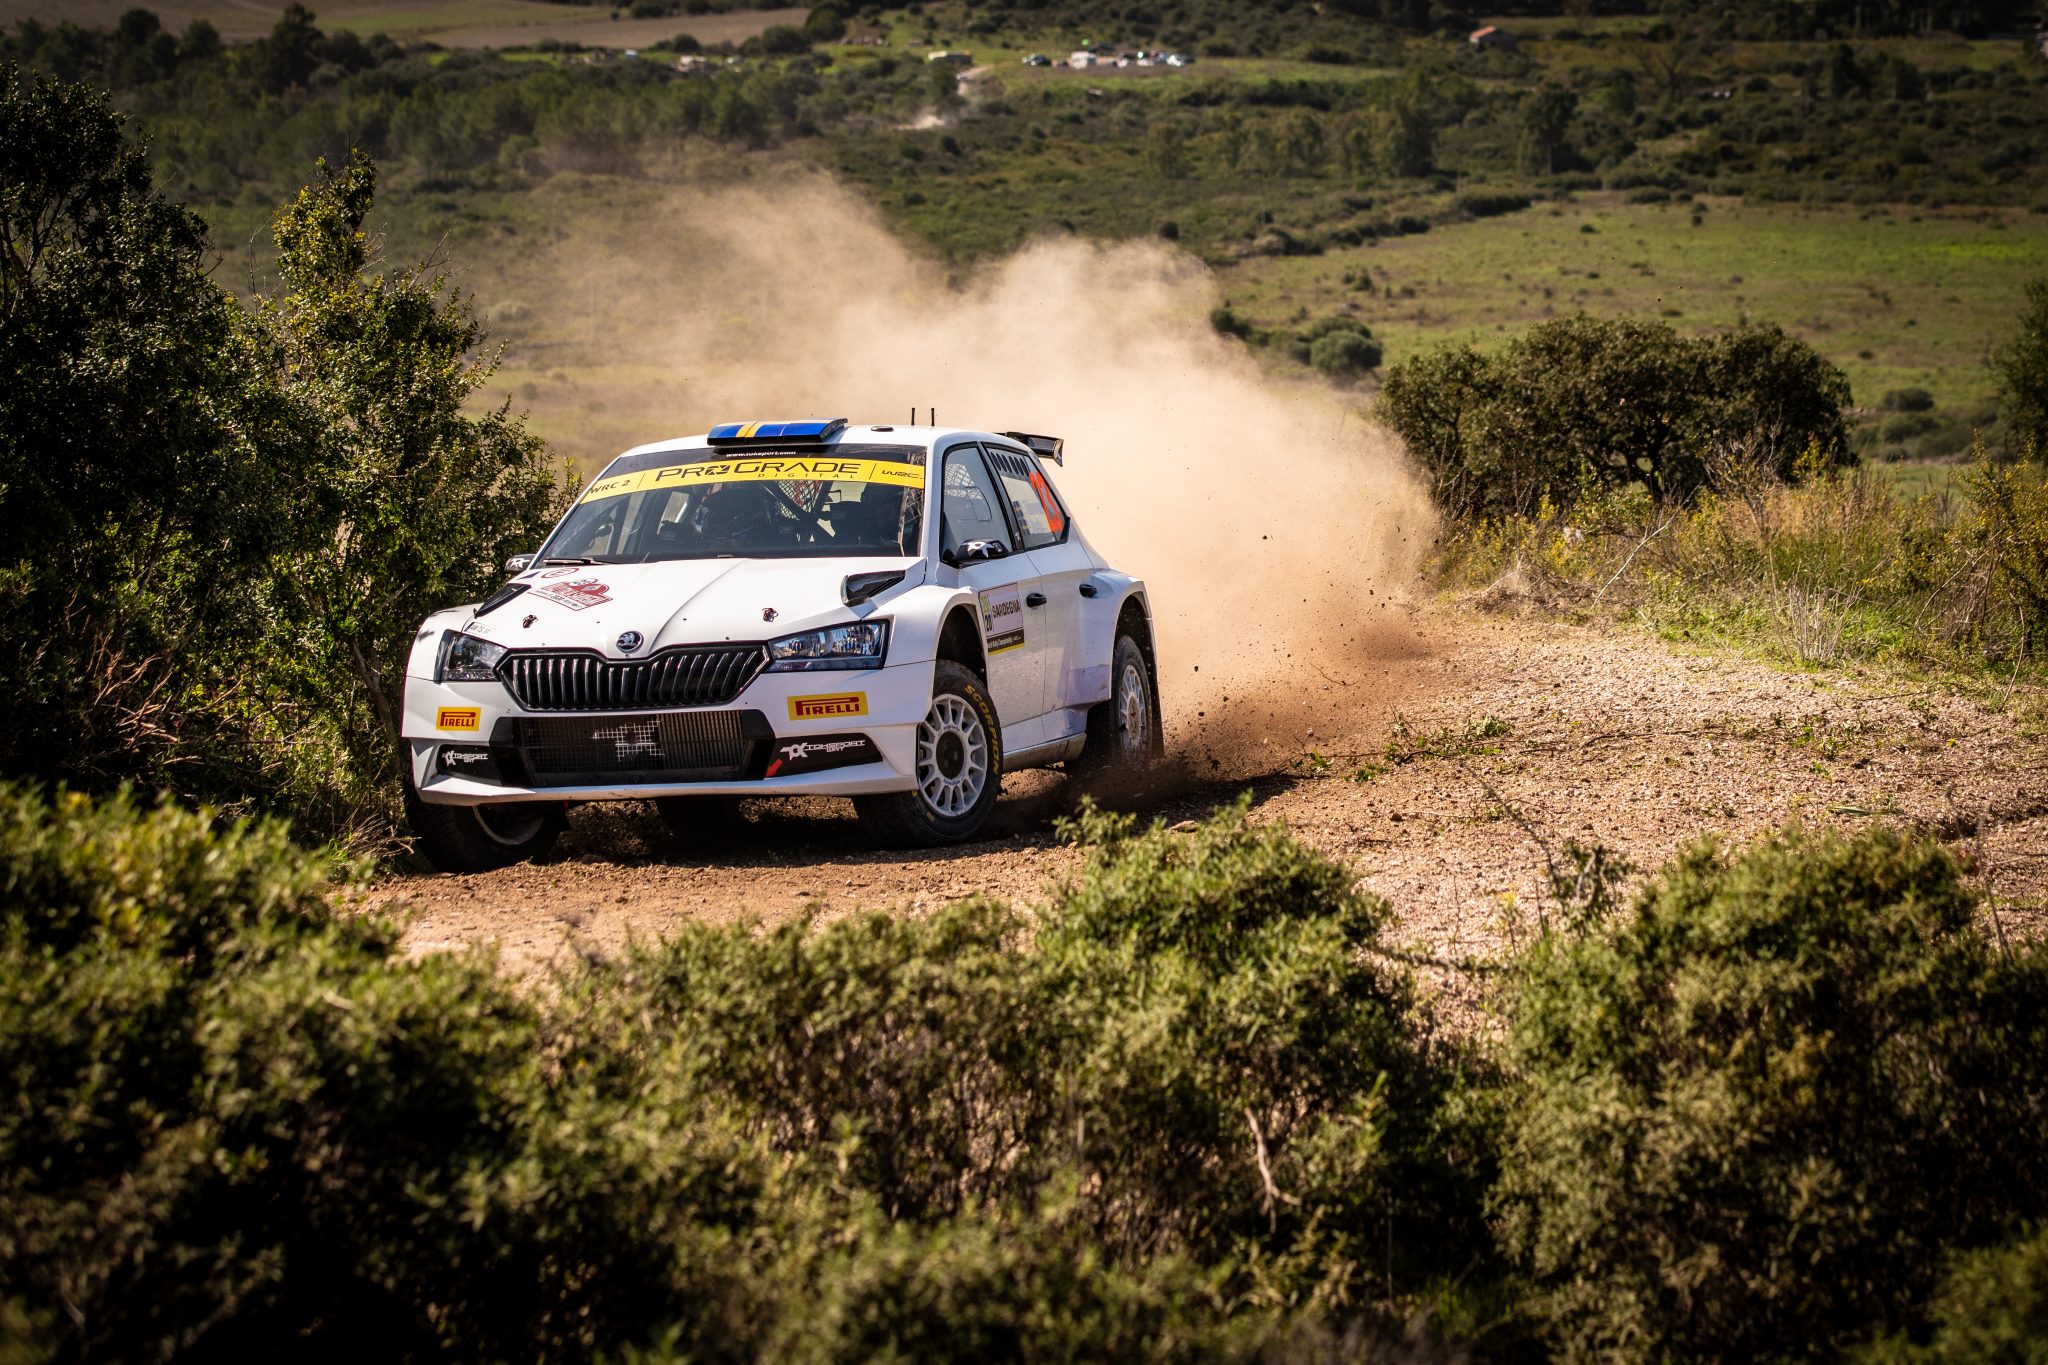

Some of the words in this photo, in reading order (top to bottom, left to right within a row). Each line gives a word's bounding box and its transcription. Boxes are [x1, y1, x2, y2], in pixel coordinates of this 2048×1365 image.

[757, 472, 856, 480] DIGITAL
[590, 482, 619, 494] WRC
[621, 479, 631, 487] 2
[991, 599, 1021, 619] SARDEGNA
[794, 696, 861, 717] PIRELLI
[439, 711, 477, 728] PIRELLI
[964, 684, 1000, 776] SCORPION
